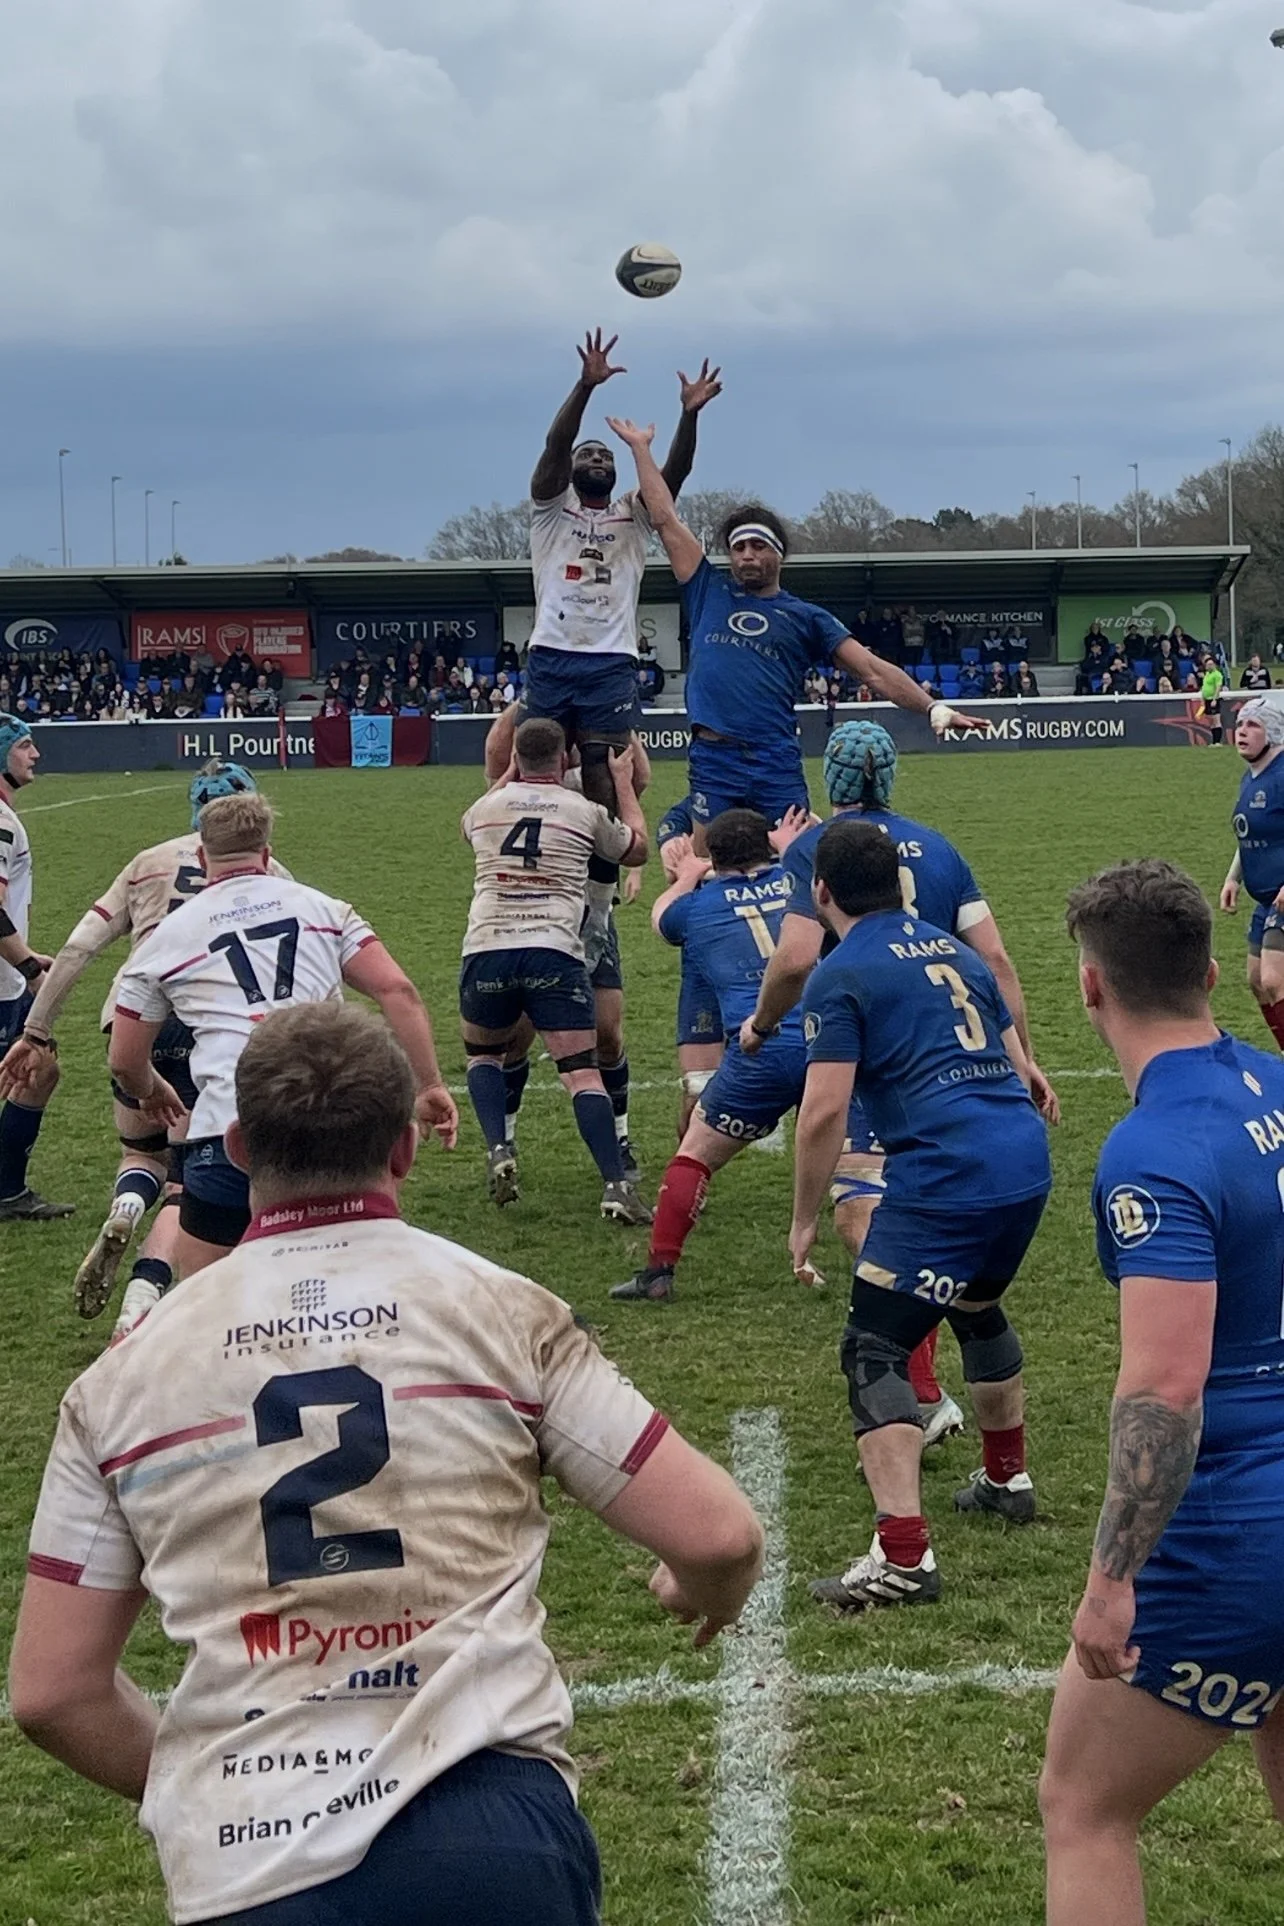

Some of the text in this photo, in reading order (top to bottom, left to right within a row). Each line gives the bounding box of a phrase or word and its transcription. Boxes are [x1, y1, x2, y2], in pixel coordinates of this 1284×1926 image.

[991, 611, 1044, 622] KITCHEN
[22, 630, 48, 644] IBS
[184, 734, 222, 756] H.L
[638, 731, 692, 748] RUGBY
[500, 816, 544, 871] 4
[724, 880, 782, 902] RAMS
[207, 916, 300, 1005] 17
[888, 938, 958, 960] RAMS
[924, 963, 988, 1052] 3
[343, 1198, 364, 1213] Ltd
[223, 1302, 399, 1347] JENKINSON
[223, 1326, 401, 1360] insurance
[253, 1364, 405, 1588] 2
[288, 1608, 438, 1666] Pyronix
[218, 1816, 292, 1848] Brian
